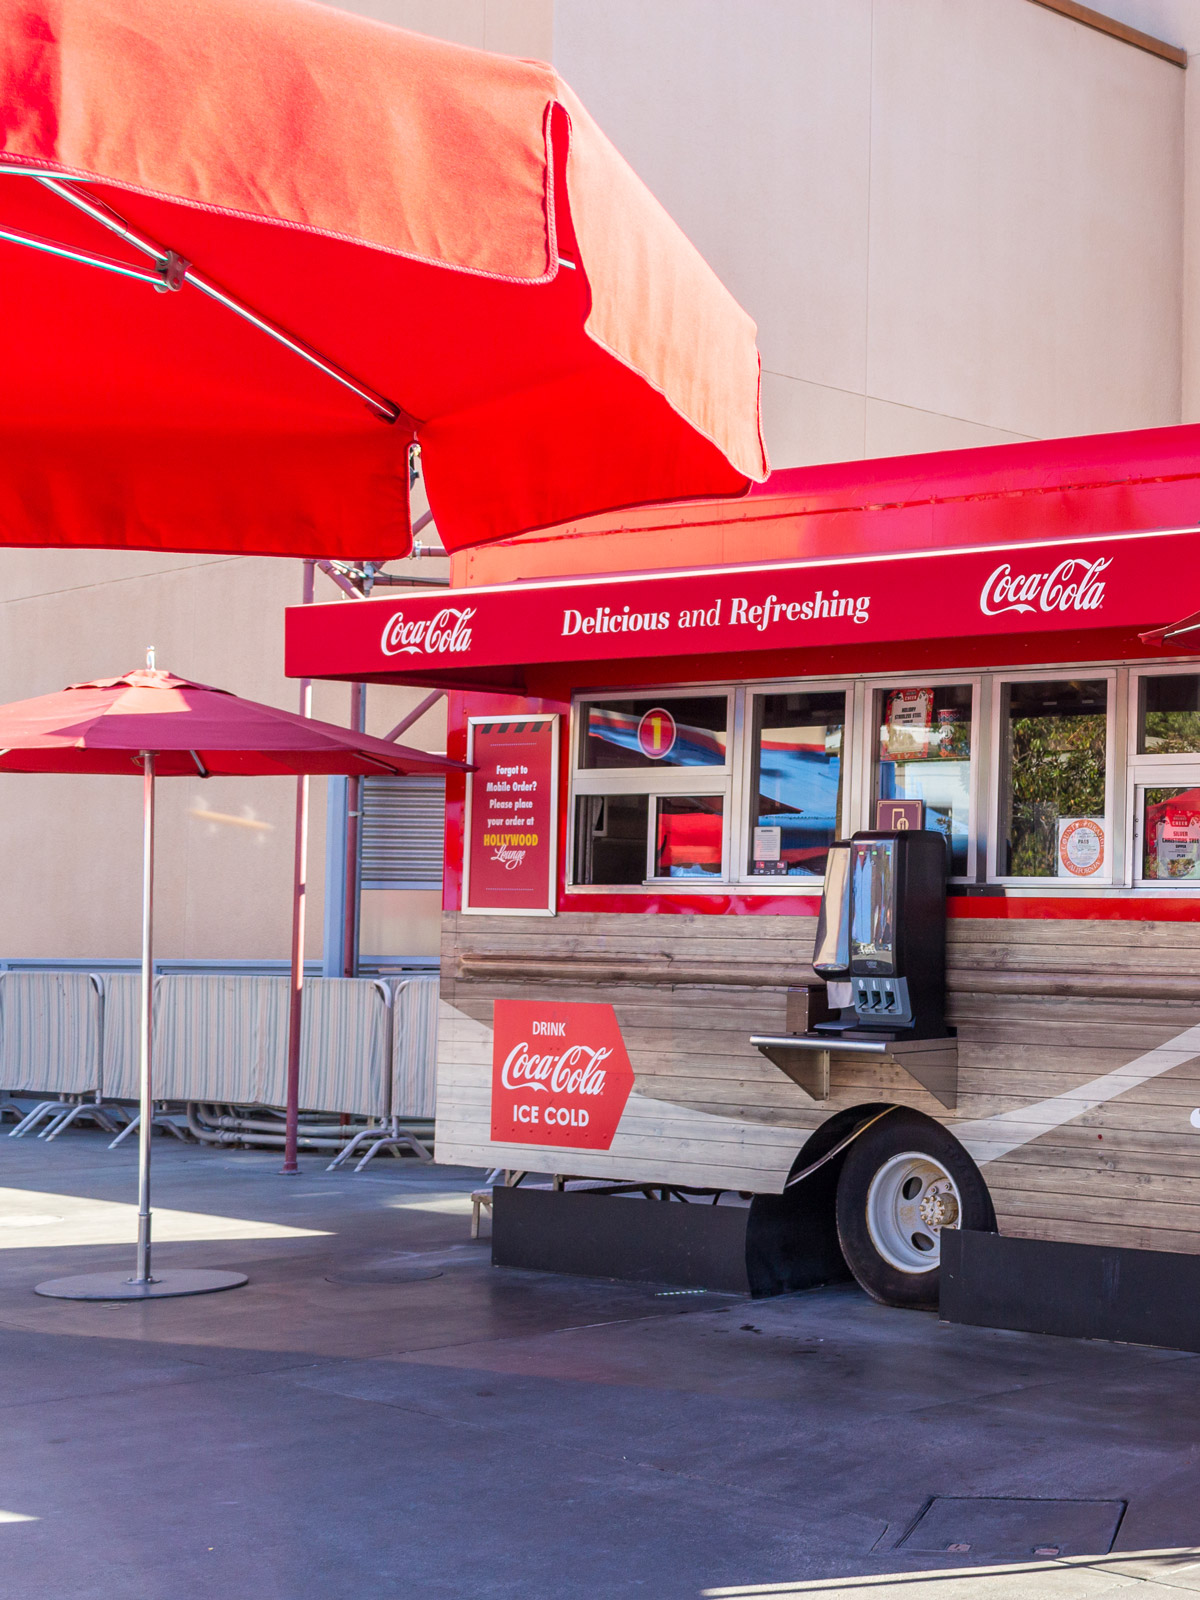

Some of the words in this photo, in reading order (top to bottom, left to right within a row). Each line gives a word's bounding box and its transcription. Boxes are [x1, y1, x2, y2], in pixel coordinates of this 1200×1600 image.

[980, 556, 1114, 616] Coca-Cola
[561, 607, 670, 636] Delicious
[678, 599, 721, 628] and
[728, 589, 870, 631] Refreshing
[381, 606, 477, 656] Coca-Cola
[651, 717, 661, 749] 1
[496, 765, 519, 777] Forgot
[520, 765, 528, 775] to
[486, 782, 510, 792] Mobile
[512, 781, 537, 791] Order?
[489, 799, 513, 809] Please
[514, 799, 533, 811] place
[487, 818, 504, 828] your
[505, 816, 525, 826] order
[527, 817, 534, 826] at
[484, 834, 538, 846] HOLLYWOOD
[491, 845, 526, 870] Lounge
[532, 1021, 566, 1037] DRINK
[501, 1042, 613, 1096] Coca-Cola
[513, 1104, 539, 1123] ICE
[544, 1107, 589, 1127] COLD
